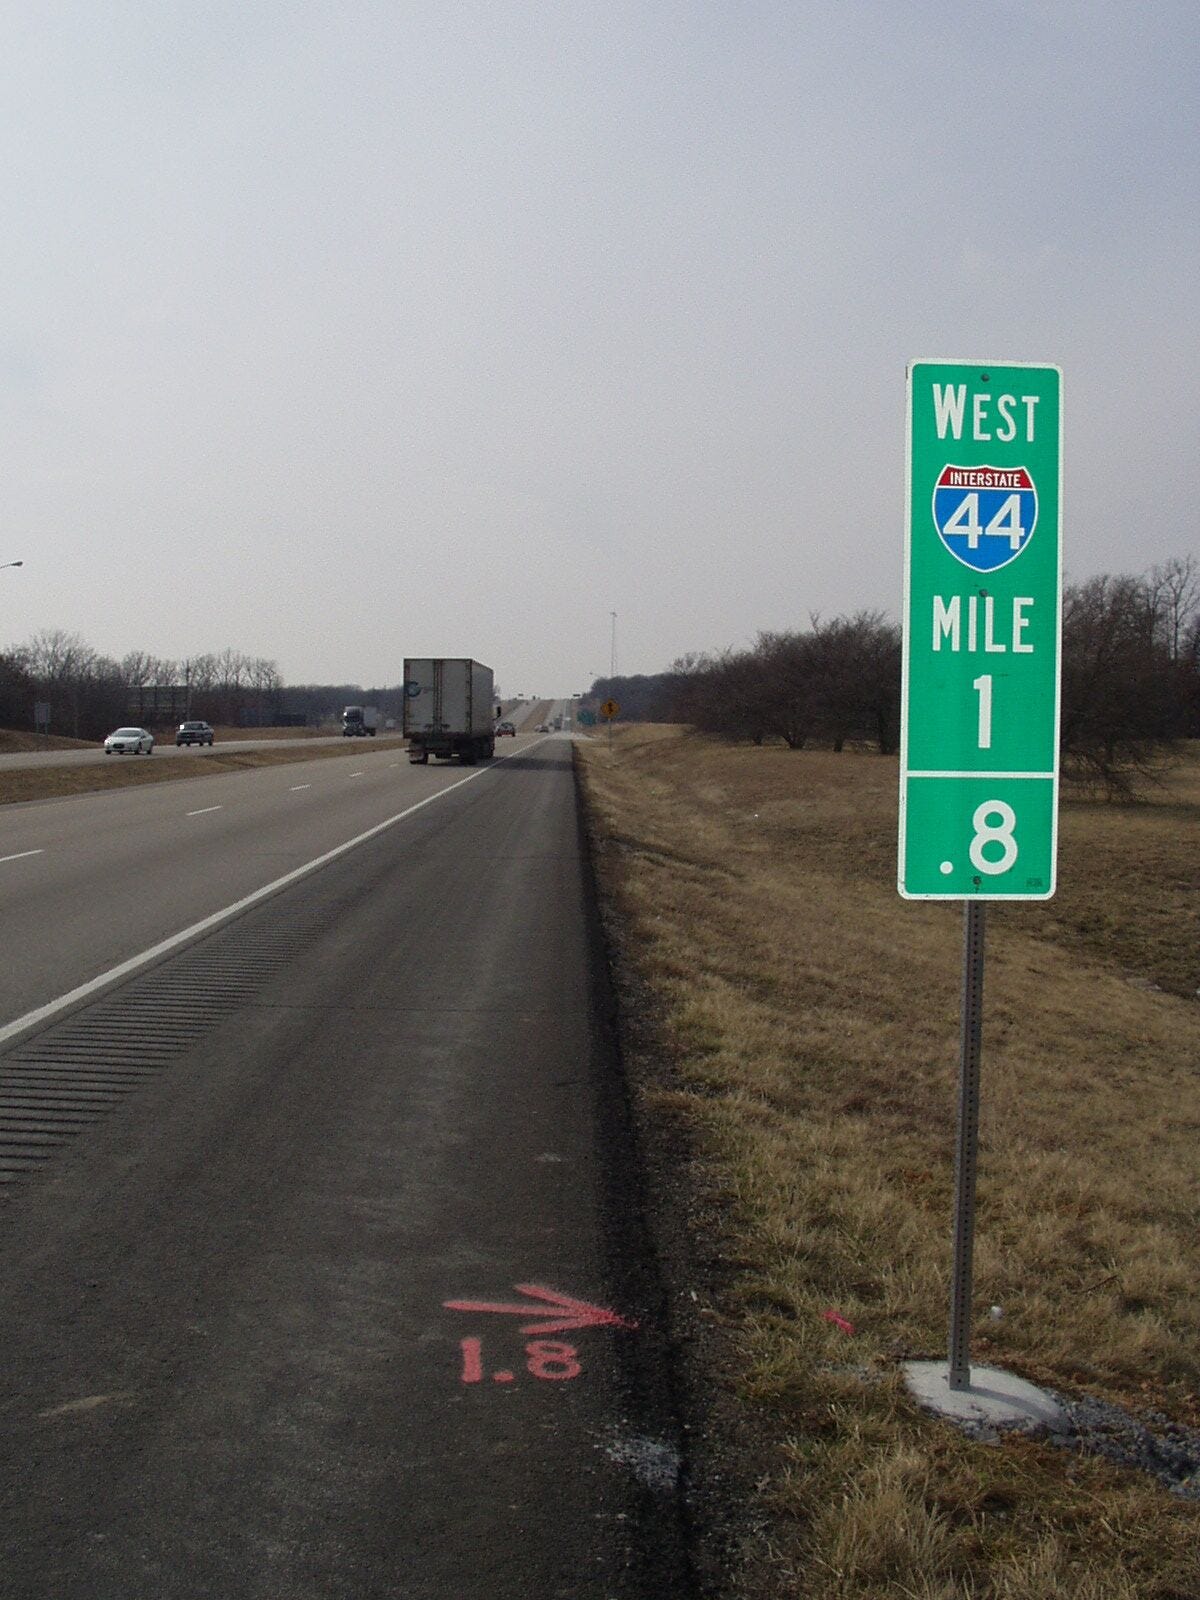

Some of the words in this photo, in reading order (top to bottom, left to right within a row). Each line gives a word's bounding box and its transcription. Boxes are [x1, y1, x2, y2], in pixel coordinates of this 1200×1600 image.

[932, 383, 1040, 442] WEST
[950, 471, 1021, 488] INTERSTATE
[942, 492, 1025, 550] 44
[932, 595, 1035, 653] MILE
[973, 674, 993, 748] 1
[460, 1337, 582, 1384] 1.8
